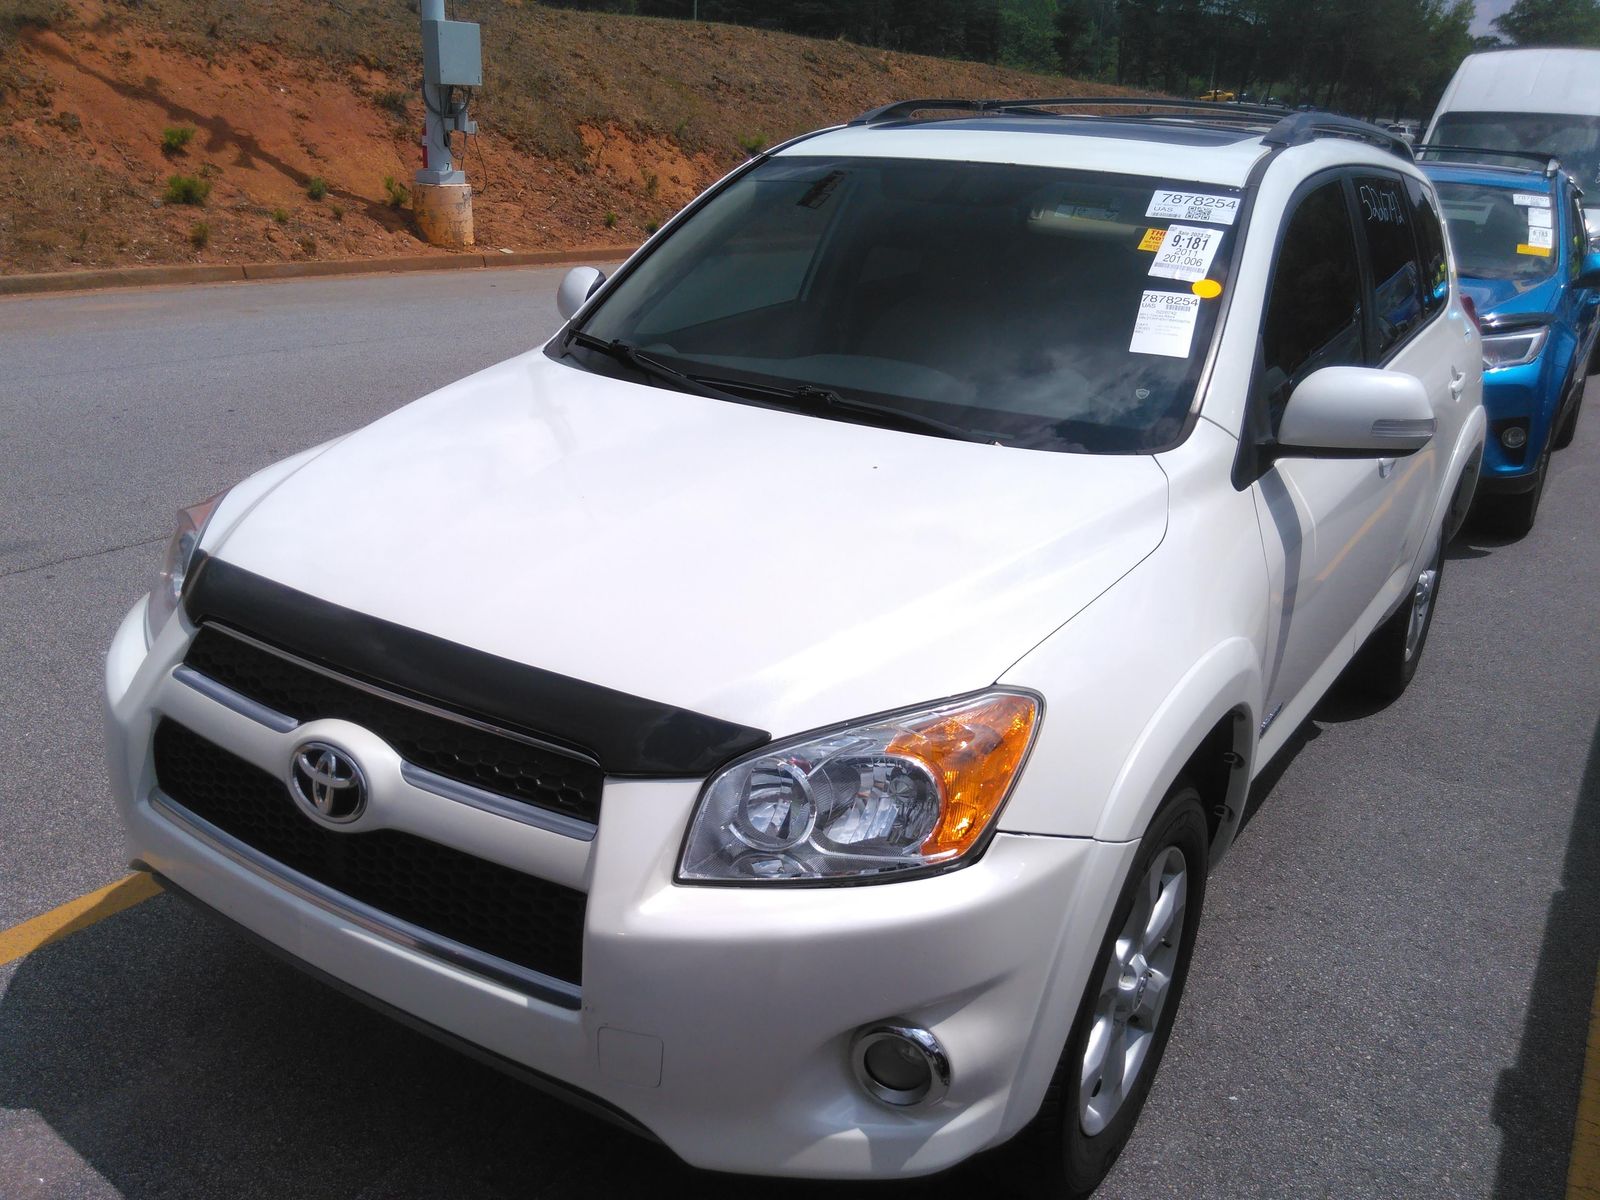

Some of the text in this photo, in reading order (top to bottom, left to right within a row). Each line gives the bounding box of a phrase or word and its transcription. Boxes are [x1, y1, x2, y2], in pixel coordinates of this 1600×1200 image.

[1162, 193, 1236, 209] 7878254
[1171, 234, 1209, 251] 9:181
[1174, 247, 1198, 257] 2011
[1142, 294, 1198, 306] 7878254
